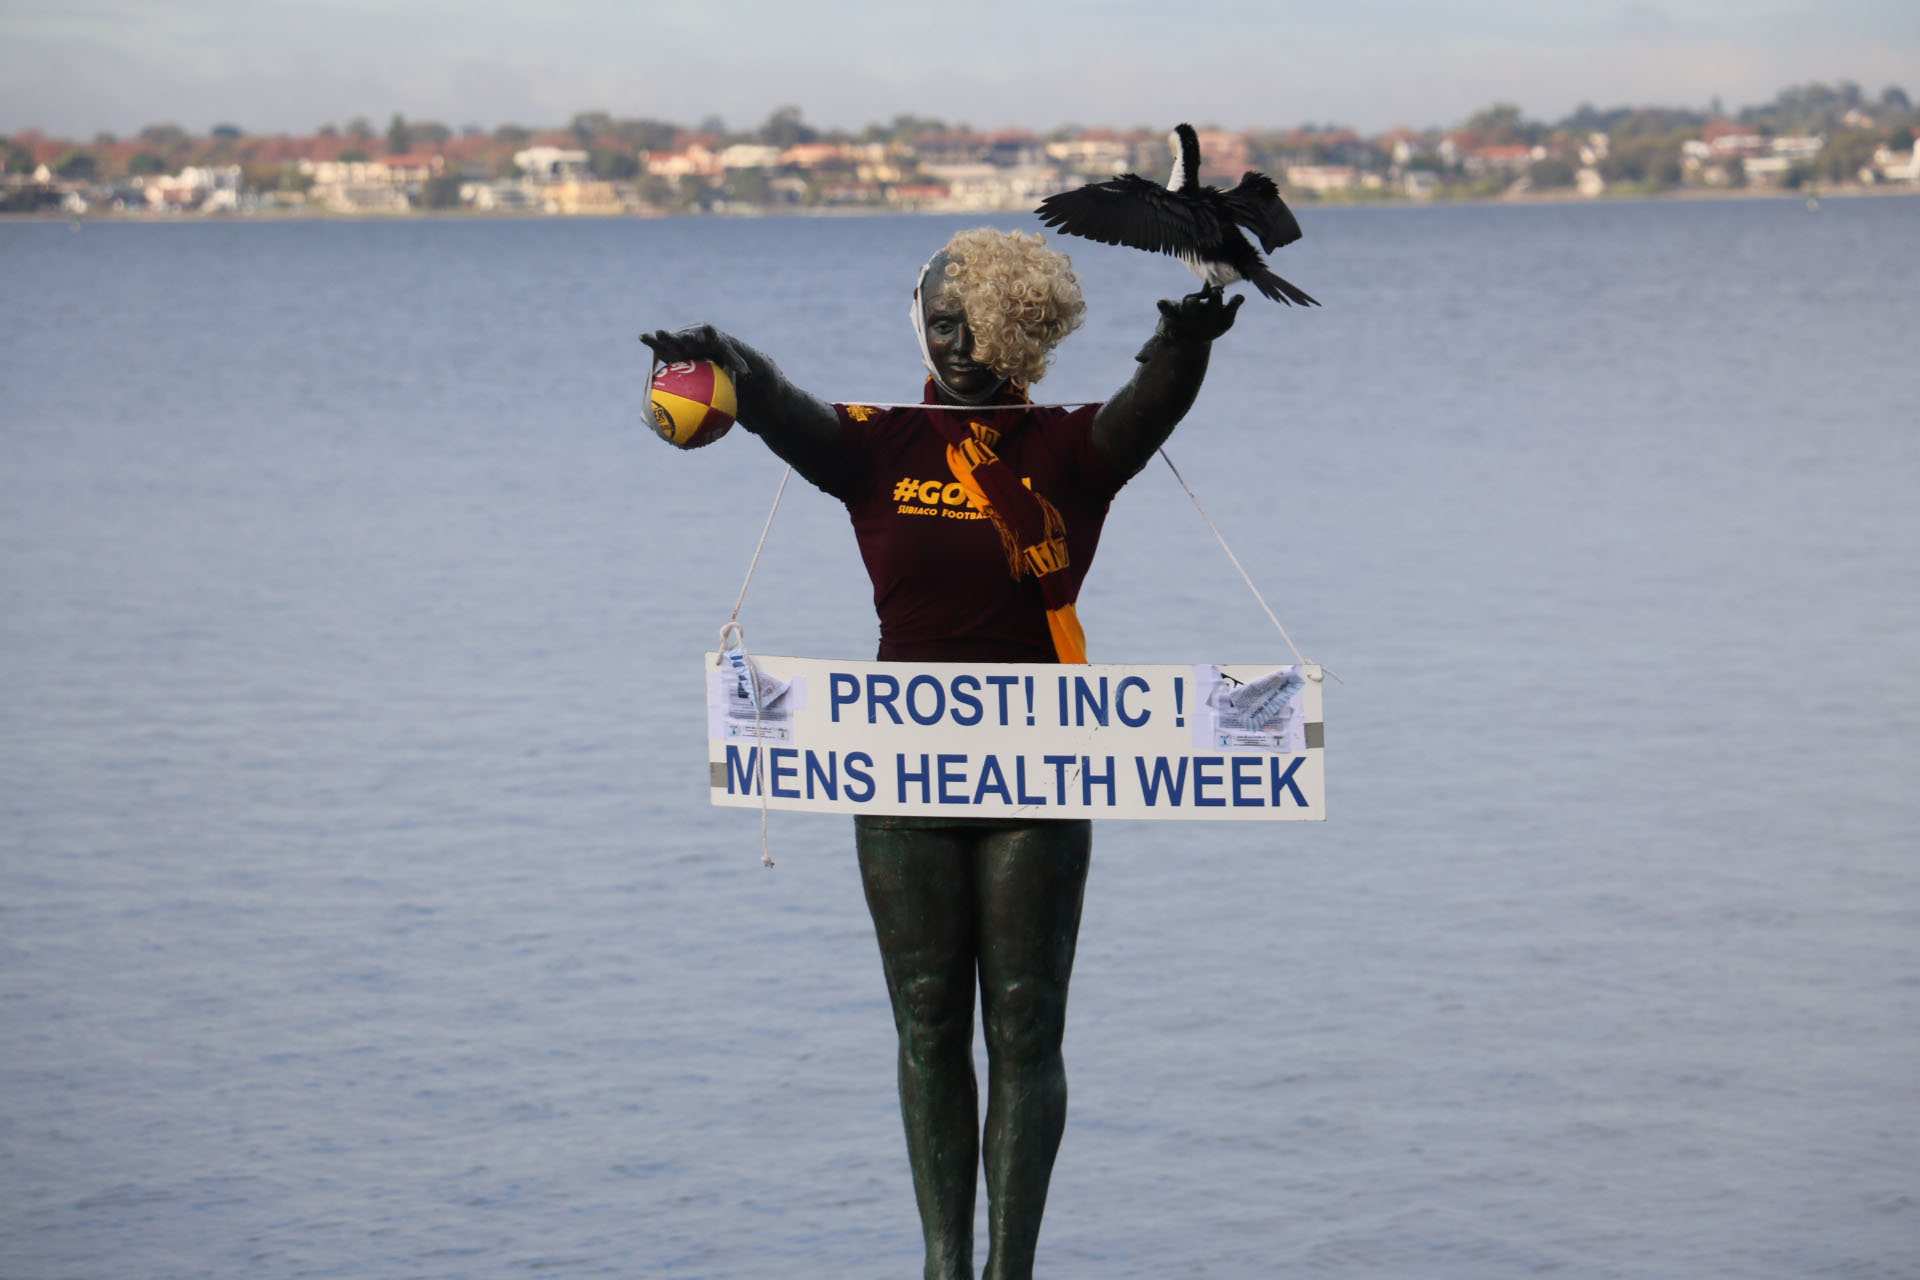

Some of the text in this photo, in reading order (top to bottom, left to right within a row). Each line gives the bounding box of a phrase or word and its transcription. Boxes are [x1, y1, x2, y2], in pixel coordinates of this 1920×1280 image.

[897, 504, 989, 520] SUBIACO FOOTBA
[829, 672, 1036, 727] PROST!
[1058, 675, 1152, 728] INC
[1173, 676, 1185, 728] !
[725, 744, 1310, 807] MENS HEALTH WEEK
